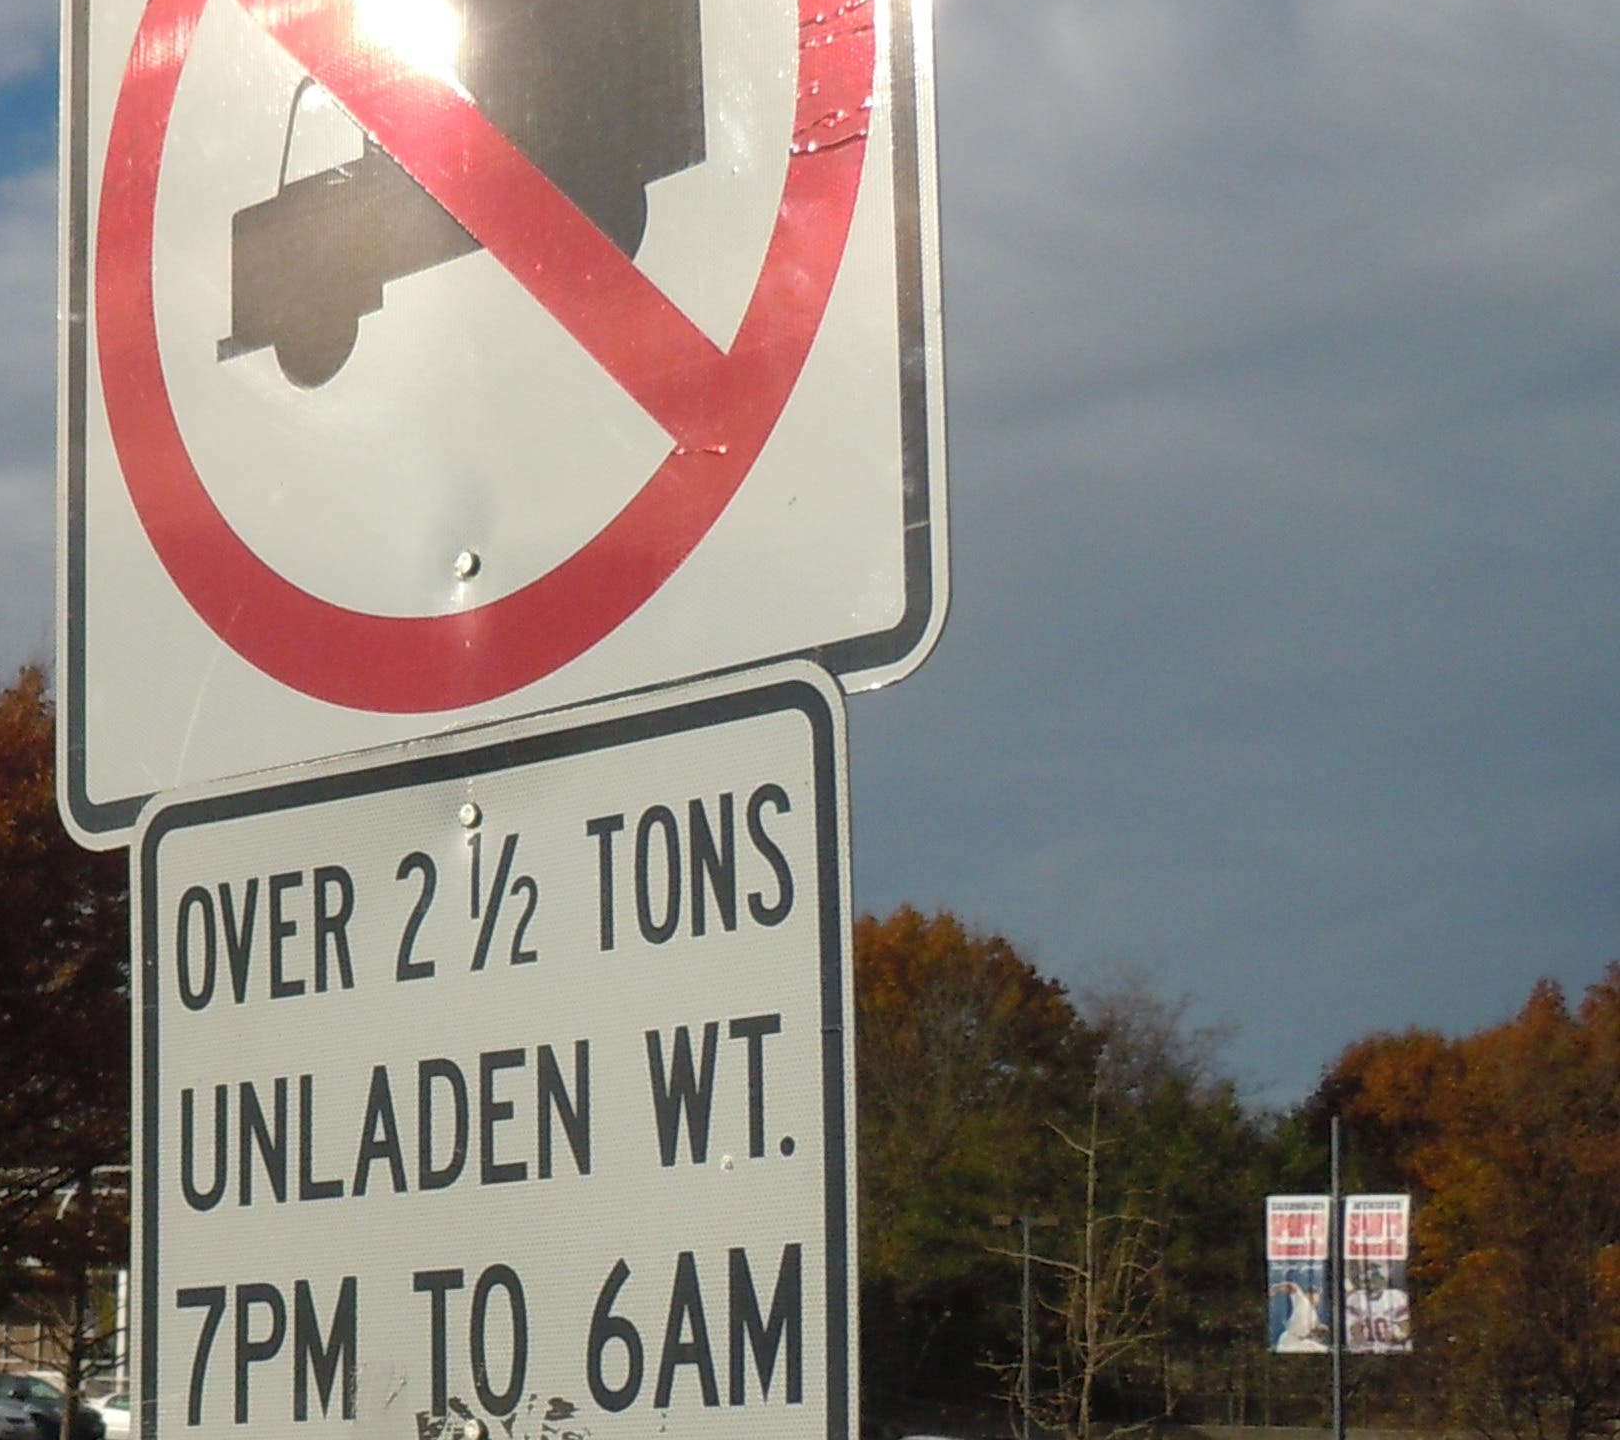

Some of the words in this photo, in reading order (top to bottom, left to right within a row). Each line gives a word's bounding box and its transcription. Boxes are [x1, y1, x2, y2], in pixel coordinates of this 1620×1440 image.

[177, 866, 355, 1011] OVER
[586, 783, 794, 951] TONS
[181, 1040, 591, 1212] UNLADEN
[645, 1014, 796, 1167] WT.
[176, 1277, 358, 1427] 7PM
[413, 1264, 529, 1418] TO
[586, 1243, 803, 1413] 6AM
